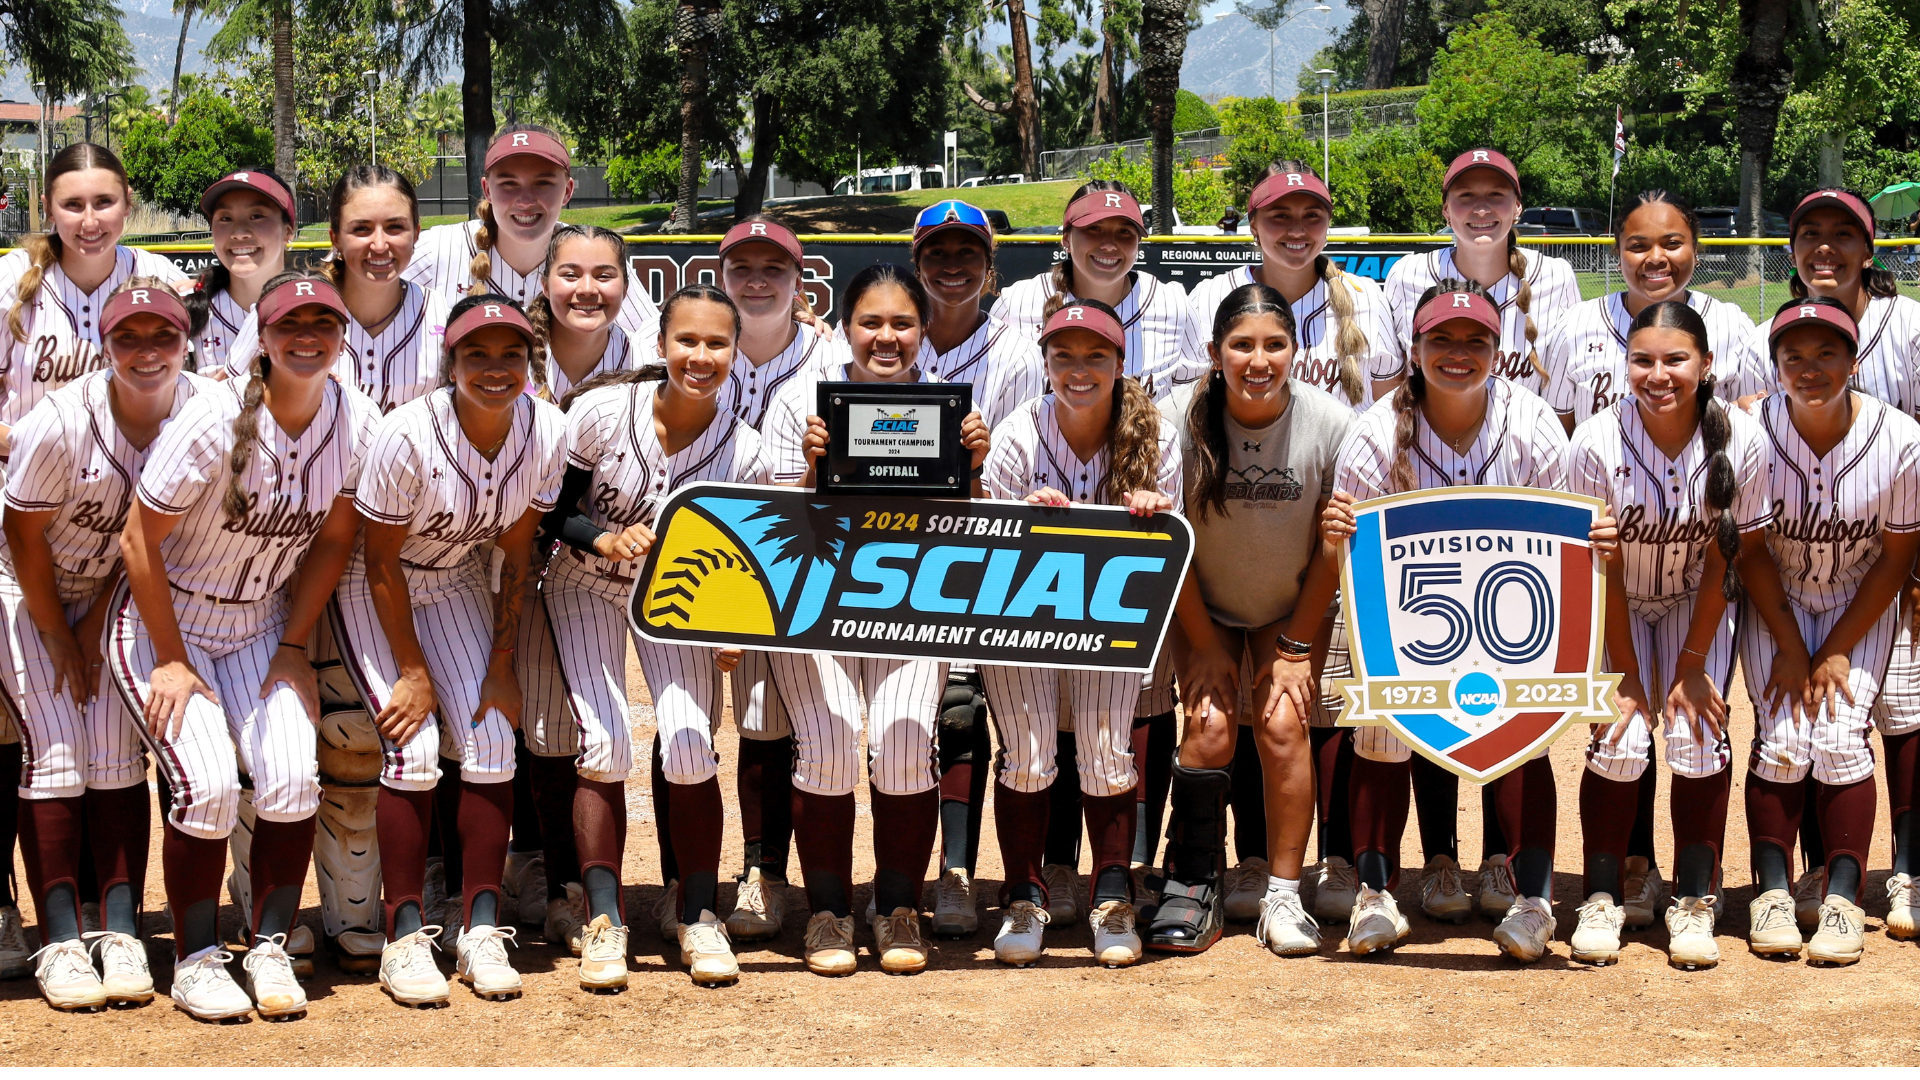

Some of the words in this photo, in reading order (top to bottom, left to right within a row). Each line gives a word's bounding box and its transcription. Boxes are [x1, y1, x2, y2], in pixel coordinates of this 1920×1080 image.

[511, 132, 530, 147] R
[1471, 150, 1490, 162] R
[1286, 173, 1305, 186] R
[1104, 193, 1122, 208] R
[749, 223, 768, 236] R
[1161, 250, 1212, 260] REGIONAL
[294, 281, 316, 297] R
[130, 289, 151, 305] R
[1452, 293, 1471, 308] R
[483, 304, 503, 318] R
[1065, 307, 1084, 321] R
[1799, 306, 1818, 318] R
[871, 419, 920, 433] SCIAC
[854, 438, 896, 446] TOURNAMENT
[898, 439, 935, 447] CHAMPIONS
[869, 465, 919, 477] SOFTBALL
[1226, 484, 1304, 501] EDLANDS
[861, 511, 920, 532] 2024
[925, 514, 1023, 538] SOFTBALL
[1390, 535, 1513, 561] DIVISION
[1526, 538, 1553, 557] III
[838, 541, 1166, 623] SCIAC
[1398, 560, 1555, 666] 50
[830, 618, 976, 645] TOURNAMENT
[978, 628, 1105, 652] CHAMPIONS
[1380, 686, 1438, 705] 1973
[1459, 693, 1499, 705] NCAA
[1515, 683, 1578, 703] 2023
